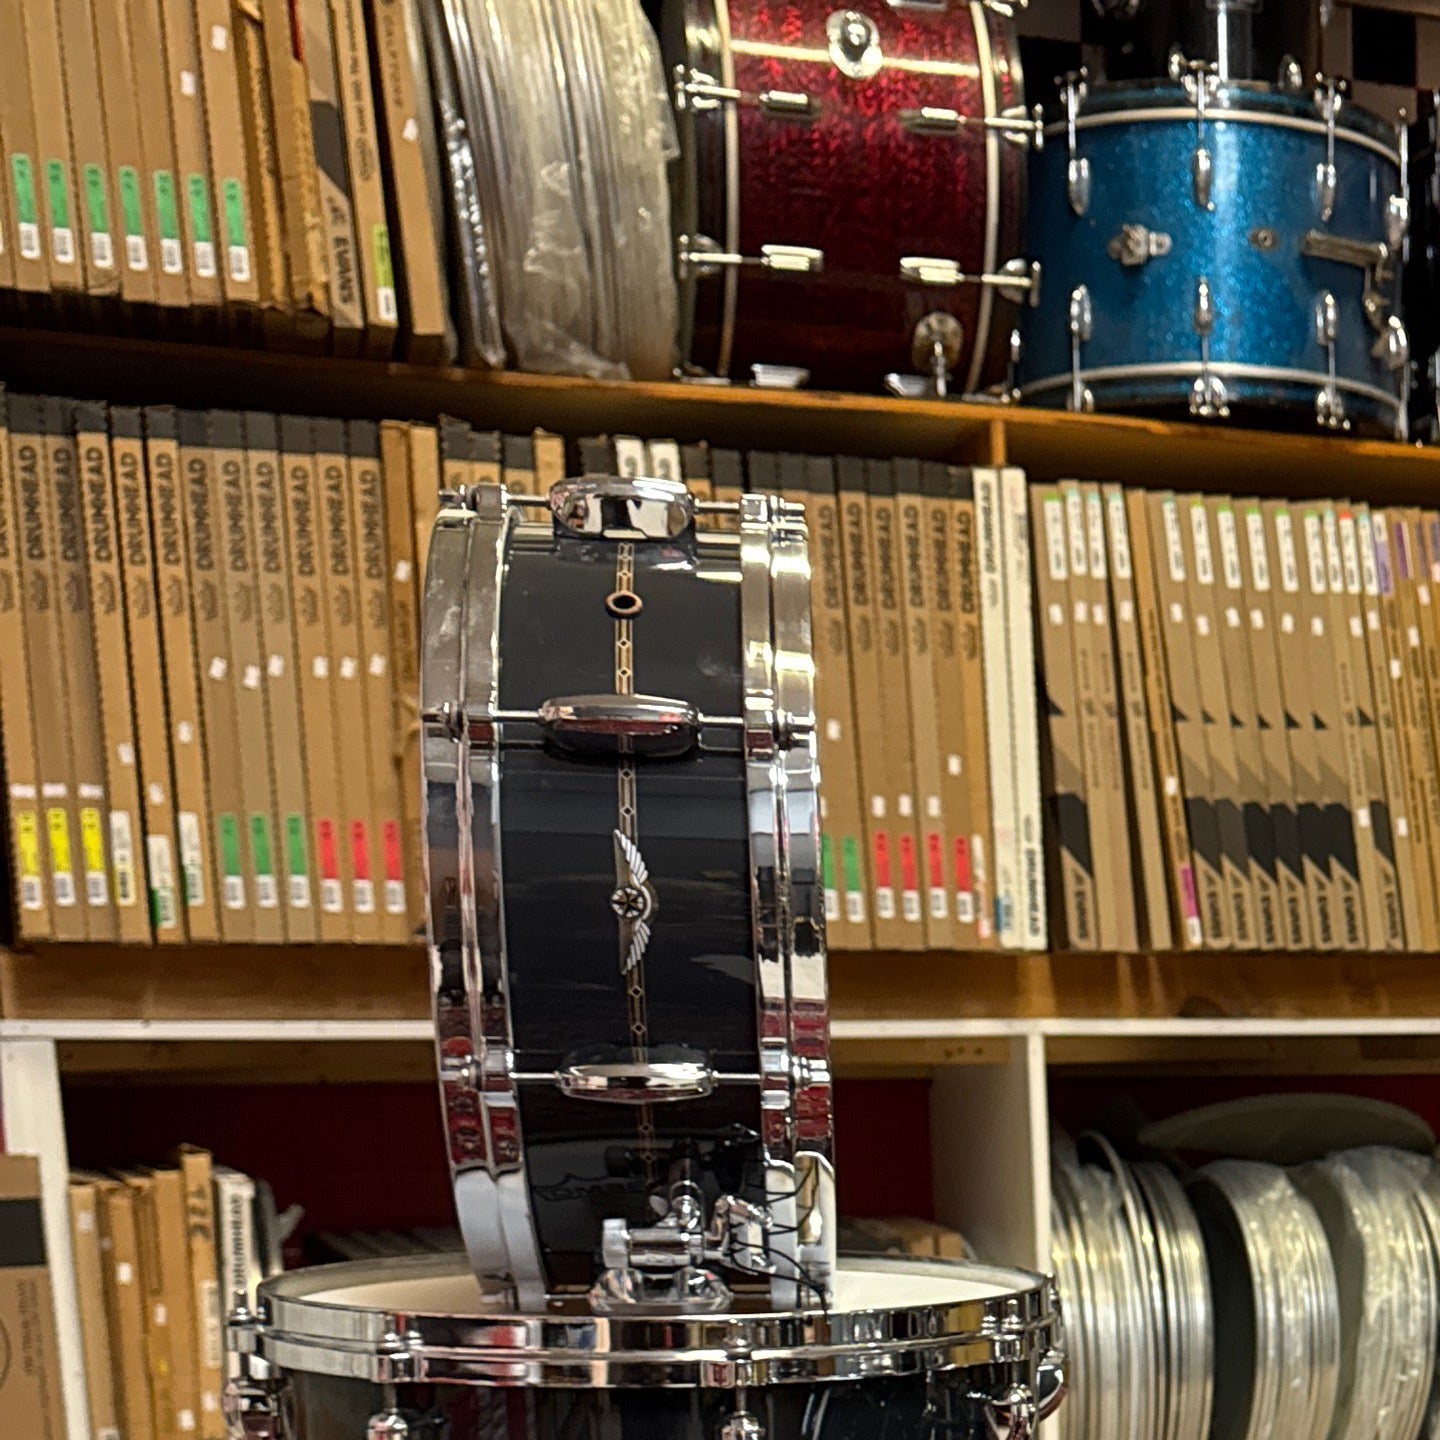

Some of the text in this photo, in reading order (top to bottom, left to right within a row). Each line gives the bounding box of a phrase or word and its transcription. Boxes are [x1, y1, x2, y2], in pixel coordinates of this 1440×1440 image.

[333, 236, 354, 304] EVANS
[18, 445, 46, 560] DRUMHEAD
[54, 448, 80, 562] DRUMHEAD
[86, 447, 112, 563] DRUMHEAD
[120, 452, 147, 566] DRUMHEAD
[156, 453, 181, 565] DRUMHEAD
[188, 458, 214, 571] DRUMHEAD
[222, 460, 248, 572] DRUMHEAD
[256, 461, 281, 573] DRUMHEAD
[290, 465, 316, 576] DRUMHEAD
[325, 465, 349, 576] DRUMHEAD
[359, 469, 382, 579] DRUMHEAD
[818, 505, 840, 610] DRUMHEAD
[846, 502, 869, 607] DRUMHEAD
[876, 506, 898, 610] DRUMHEAD
[903, 505, 925, 608] DRUMHEAD
[931, 509, 952, 611] DRUMHEAD
[957, 510, 977, 614] DRUMHEAD
